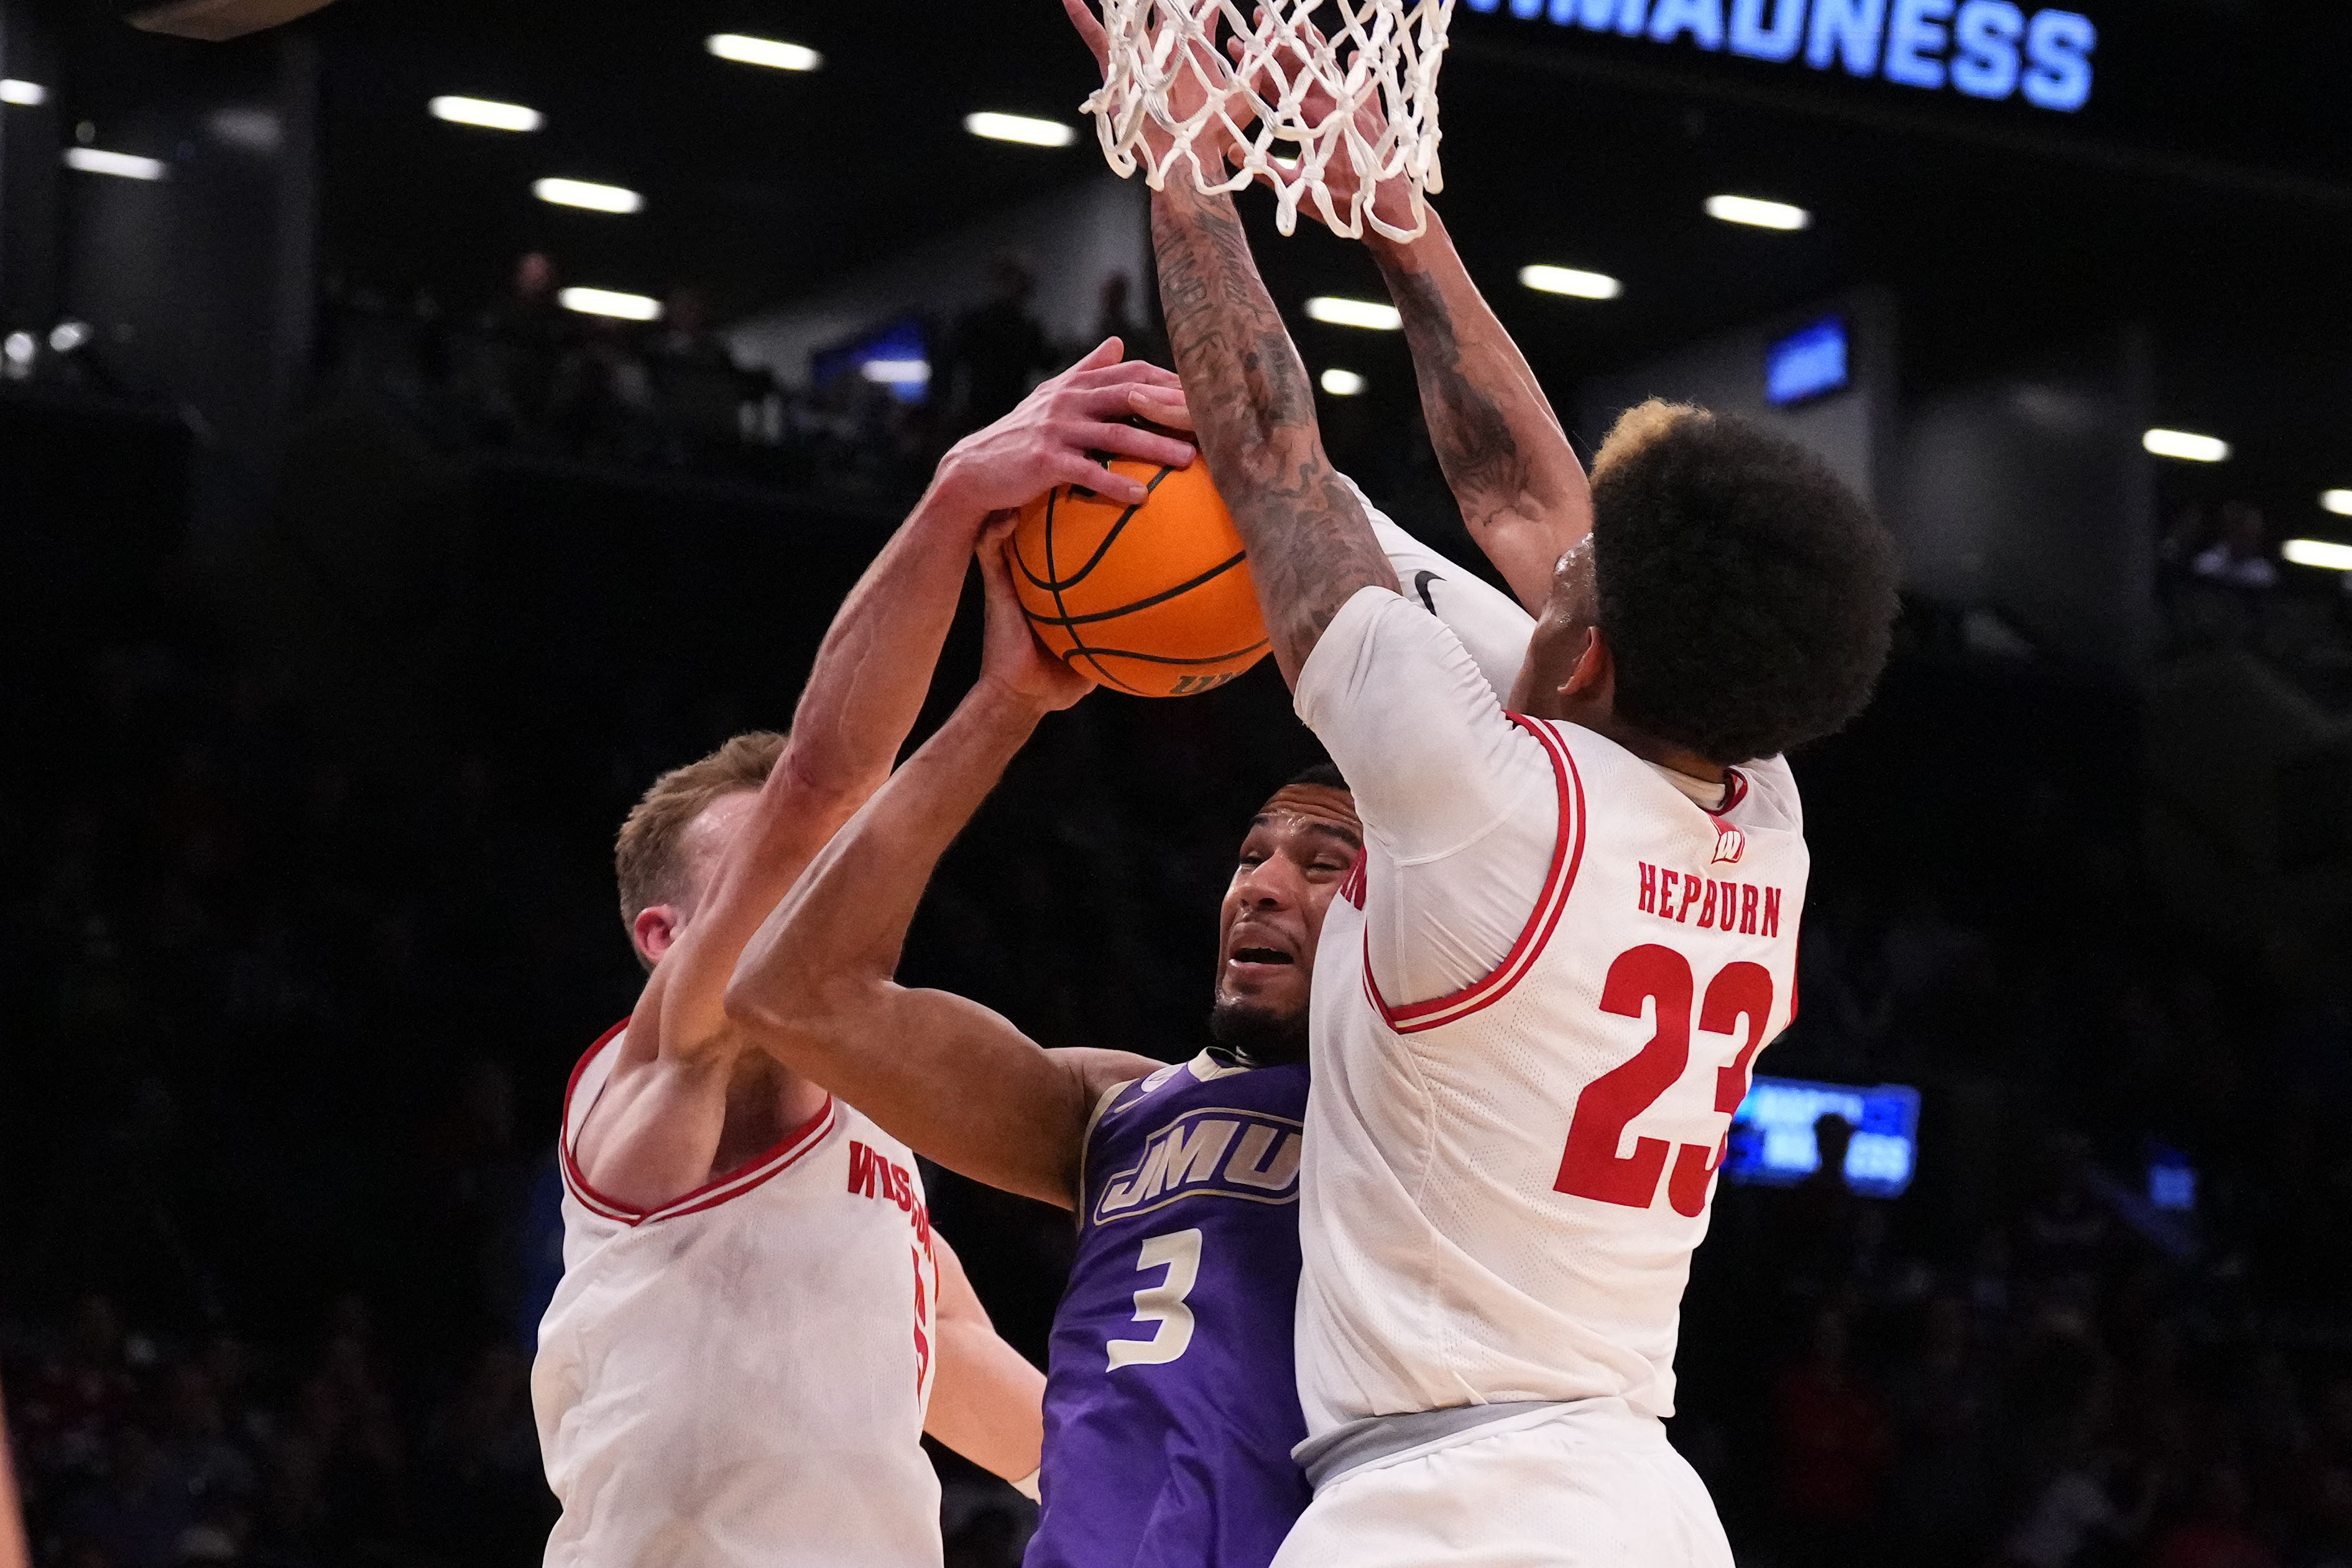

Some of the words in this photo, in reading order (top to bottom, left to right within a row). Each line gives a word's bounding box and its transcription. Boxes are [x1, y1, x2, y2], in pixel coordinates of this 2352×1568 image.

[1638, 860, 1782, 938] HEPBURN
[1553, 943, 1774, 1218] 23
[1100, 1120, 1303, 1213] JMU
[1105, 1228, 1202, 1373] 3
